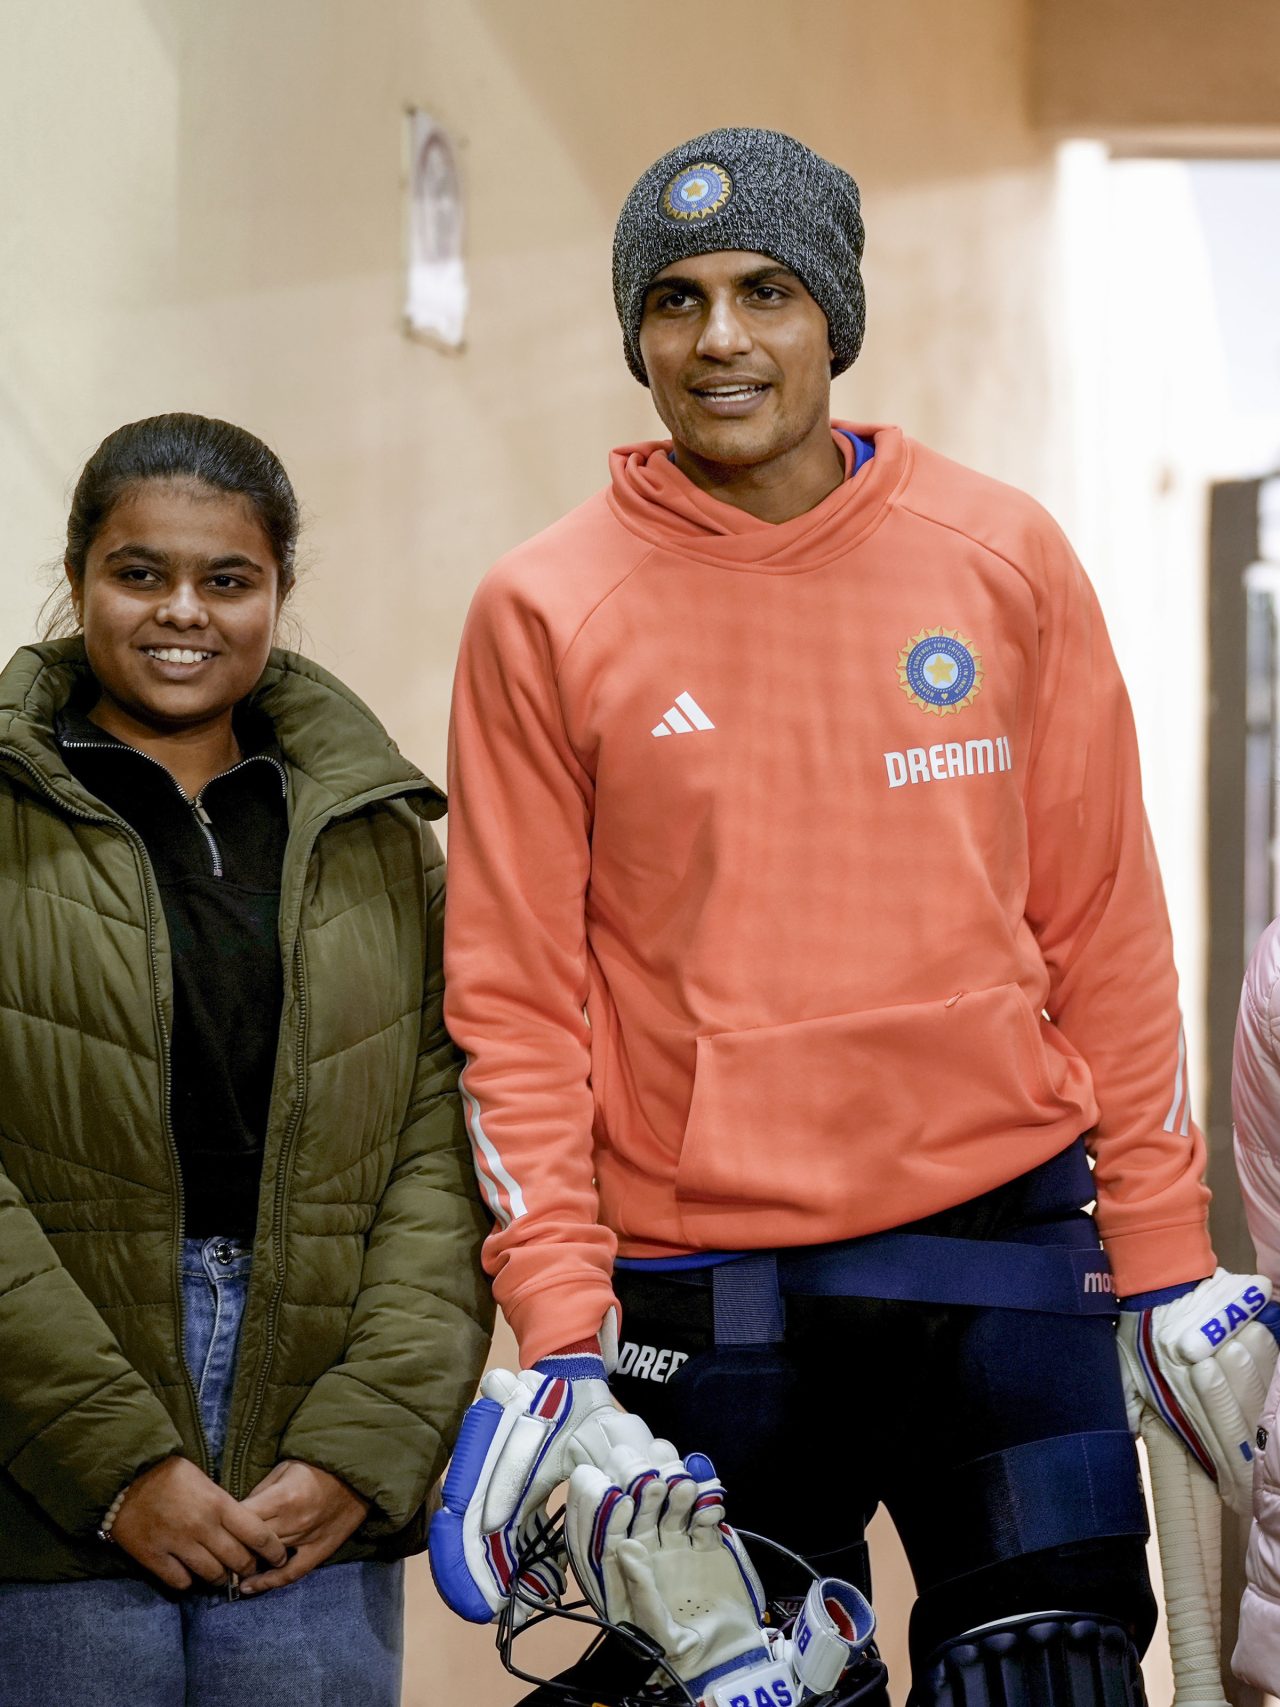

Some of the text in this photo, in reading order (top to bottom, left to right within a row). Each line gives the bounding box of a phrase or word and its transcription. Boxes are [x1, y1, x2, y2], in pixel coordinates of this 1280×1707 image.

[913, 645, 932, 669] CONTROL
[947, 645, 968, 666] CRICKET
[954, 678, 968, 694] INDIA
[883, 736, 1012, 789] DREAM11
[1084, 1272, 1116, 1294] mo
[1200, 1285, 1267, 1347] BAS
